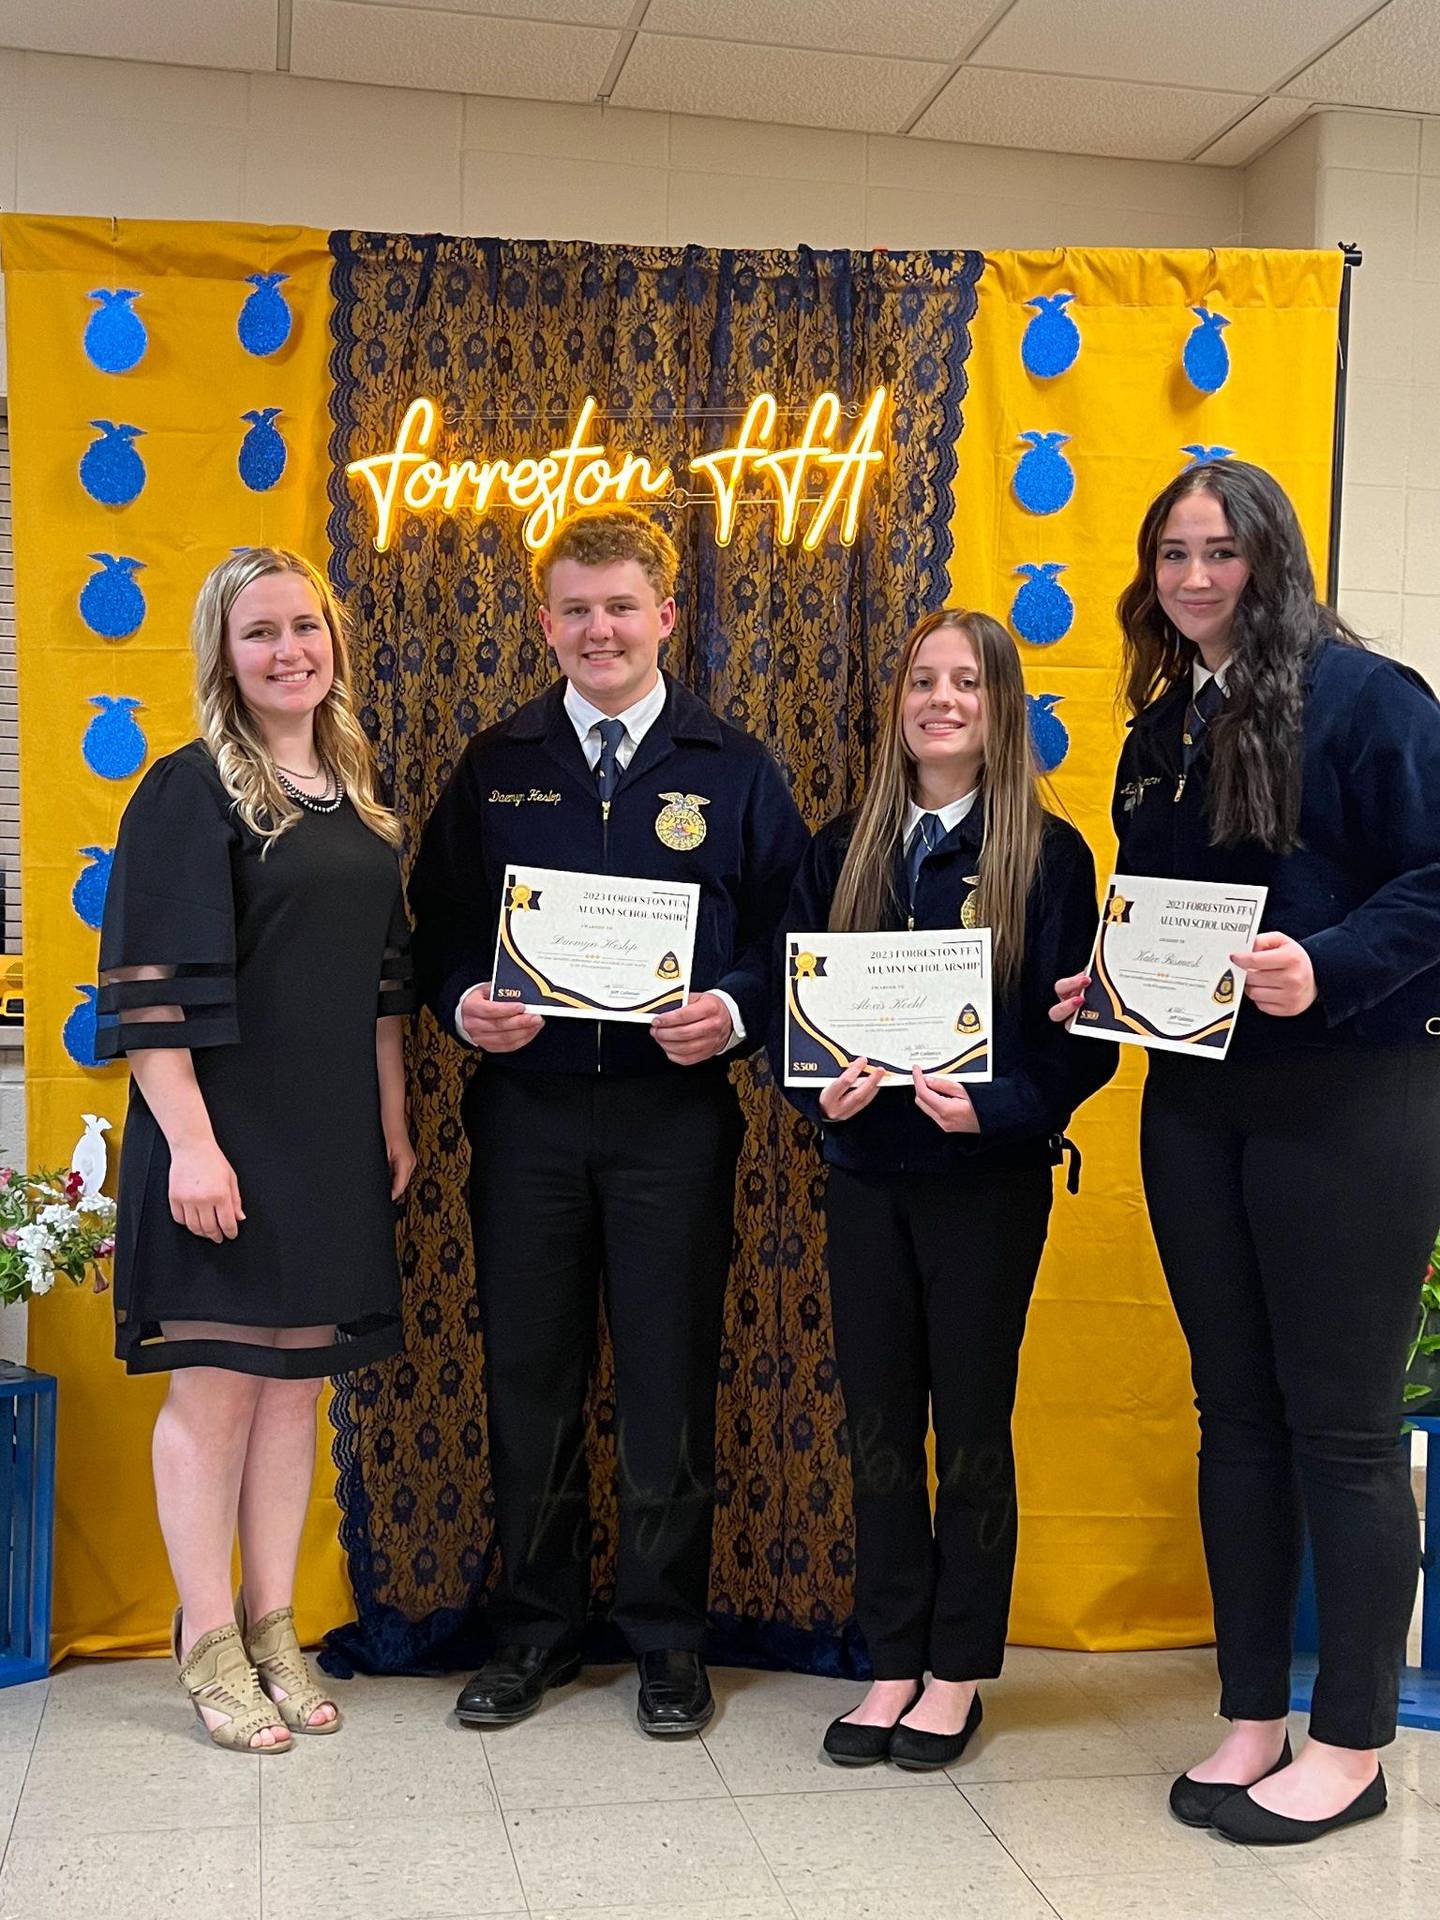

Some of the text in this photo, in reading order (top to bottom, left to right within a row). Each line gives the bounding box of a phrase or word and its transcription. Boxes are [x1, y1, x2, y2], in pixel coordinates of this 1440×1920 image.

[346, 386, 886, 552] Forreston FFA
[583, 891, 687, 908] 2023 FORRESTON FFA
[1165, 900, 1253, 916] 2023 FORRESTON FFA
[578, 905, 686, 922] ALUMNI SCHOLARSHIP
[1161, 915, 1250, 933] ALUMNI SCHOLARSHIP
[870, 946, 980, 960] 2023 FORRESTON FFA
[866, 961, 980, 975] ALUMNI SCHOLARSHIP
